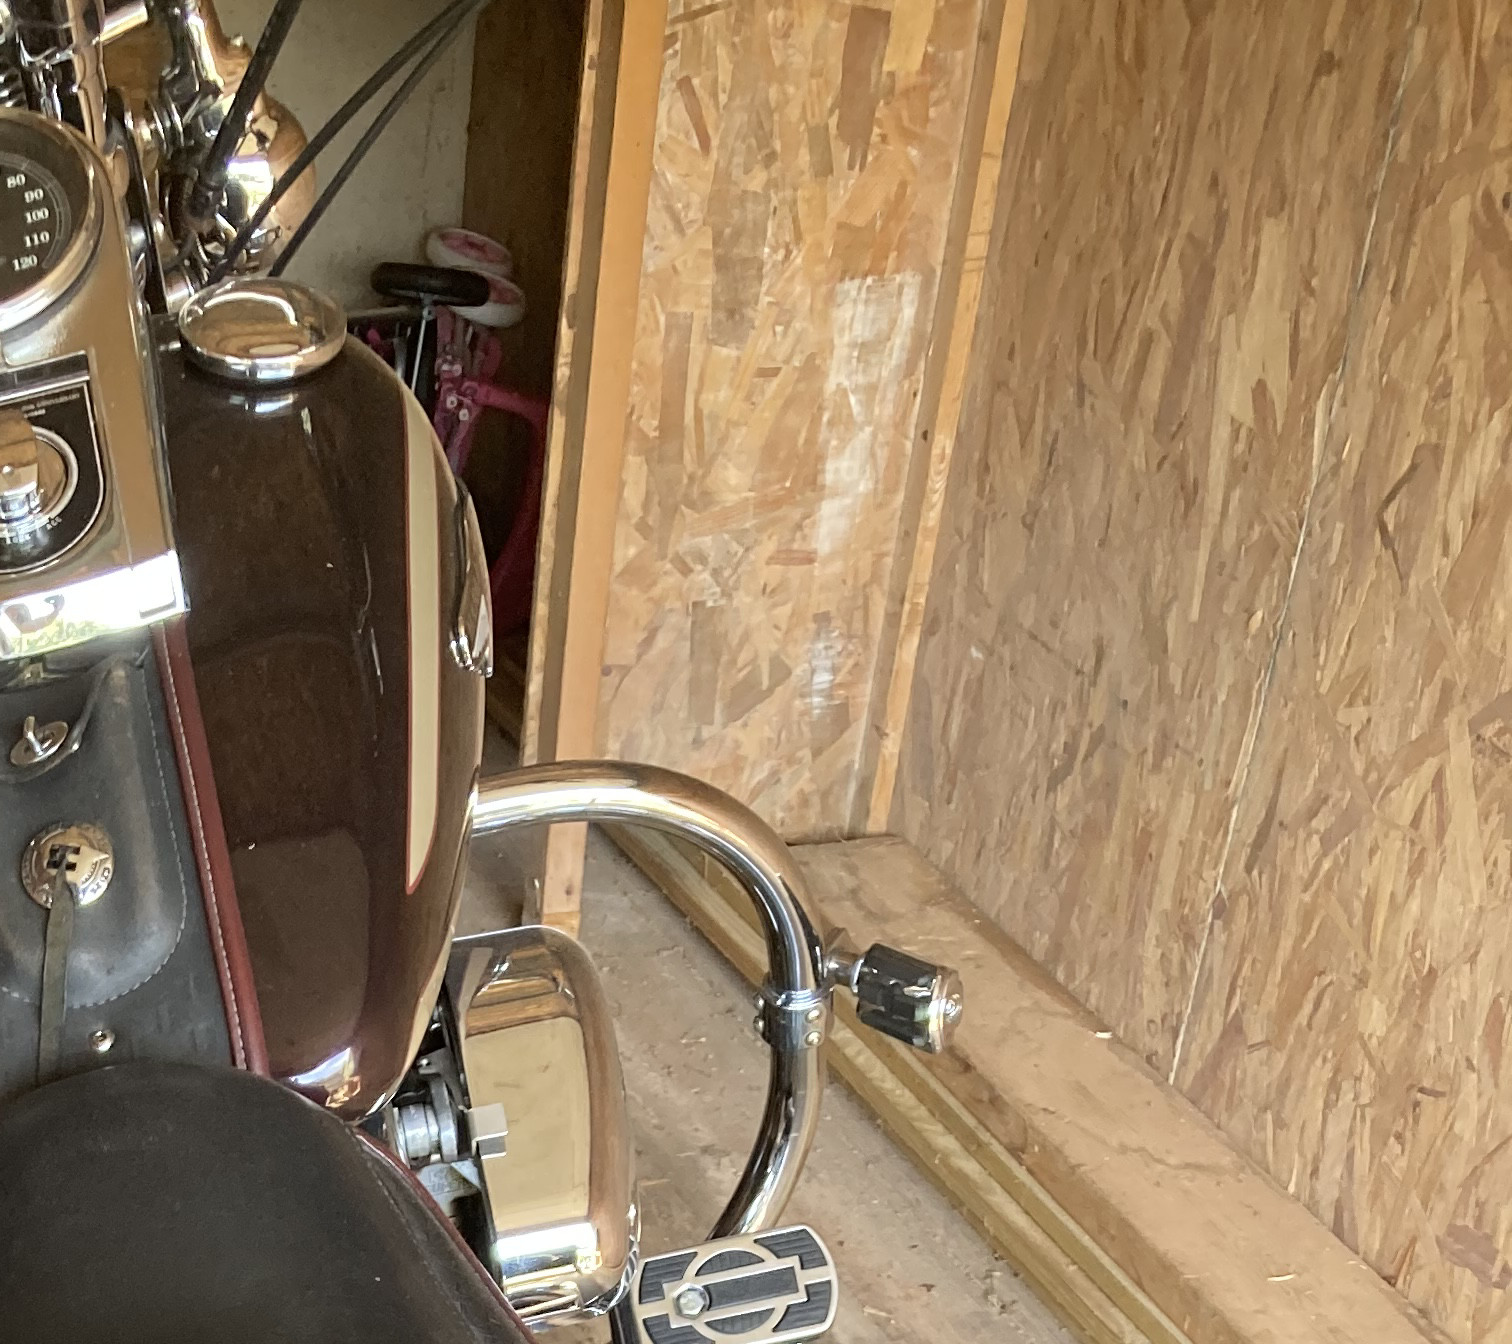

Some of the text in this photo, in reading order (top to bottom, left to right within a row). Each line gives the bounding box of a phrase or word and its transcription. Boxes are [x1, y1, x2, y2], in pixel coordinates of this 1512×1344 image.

[6, 173, 26, 189] 80
[24, 188, 44, 203] 90
[24, 207, 50, 223] 100
[23, 231, 50, 248] 110
[11, 255, 39, 272] 120
